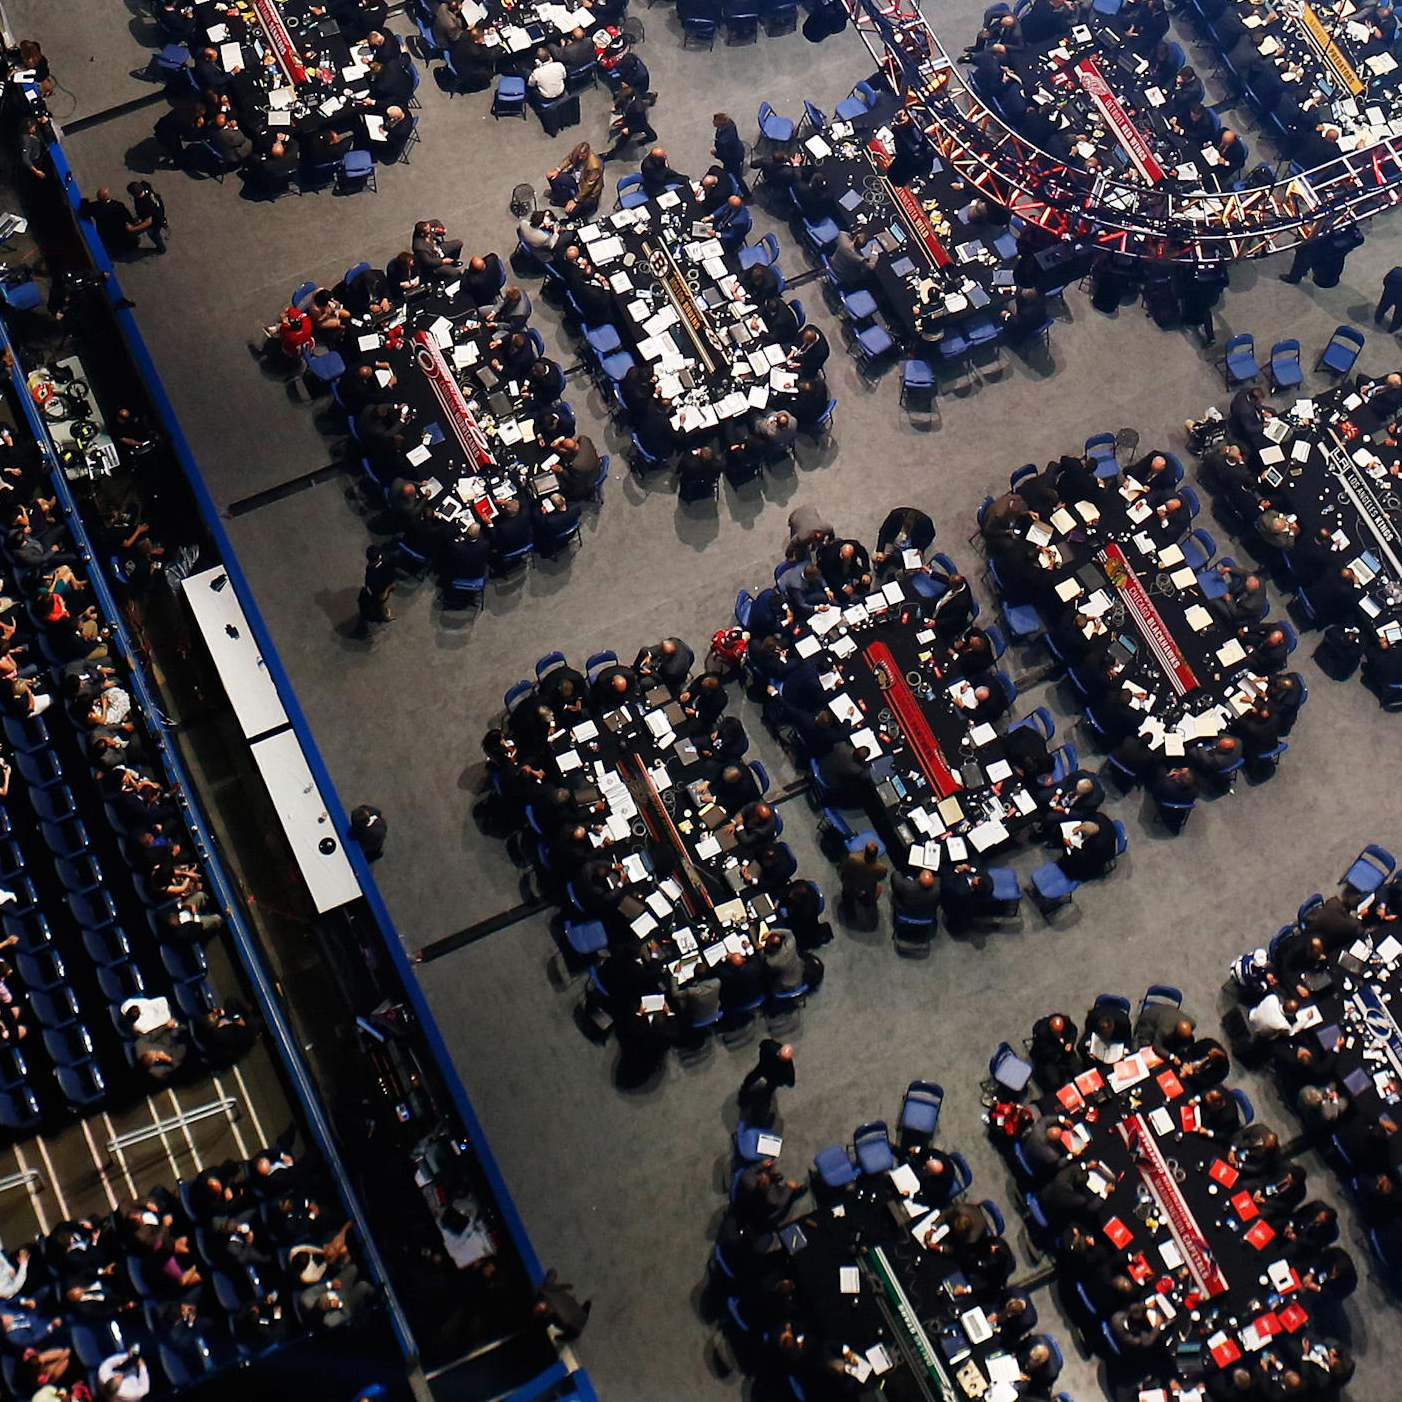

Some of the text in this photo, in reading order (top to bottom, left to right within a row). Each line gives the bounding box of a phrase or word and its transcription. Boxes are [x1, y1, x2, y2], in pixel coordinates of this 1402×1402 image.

[1327, 47, 1355, 85] PREDATORS
[1103, 98, 1148, 162] DETROIT RED WINGS
[914, 218, 930, 238] WILD
[1347, 473, 1394, 542] LOS ANGELES KINGS
[1127, 586, 1151, 618] CHICAGO
[1145, 616, 1181, 669] BLACKHAWKS
[1152, 1177, 1211, 1279] WASHINGTON CAPITALS
